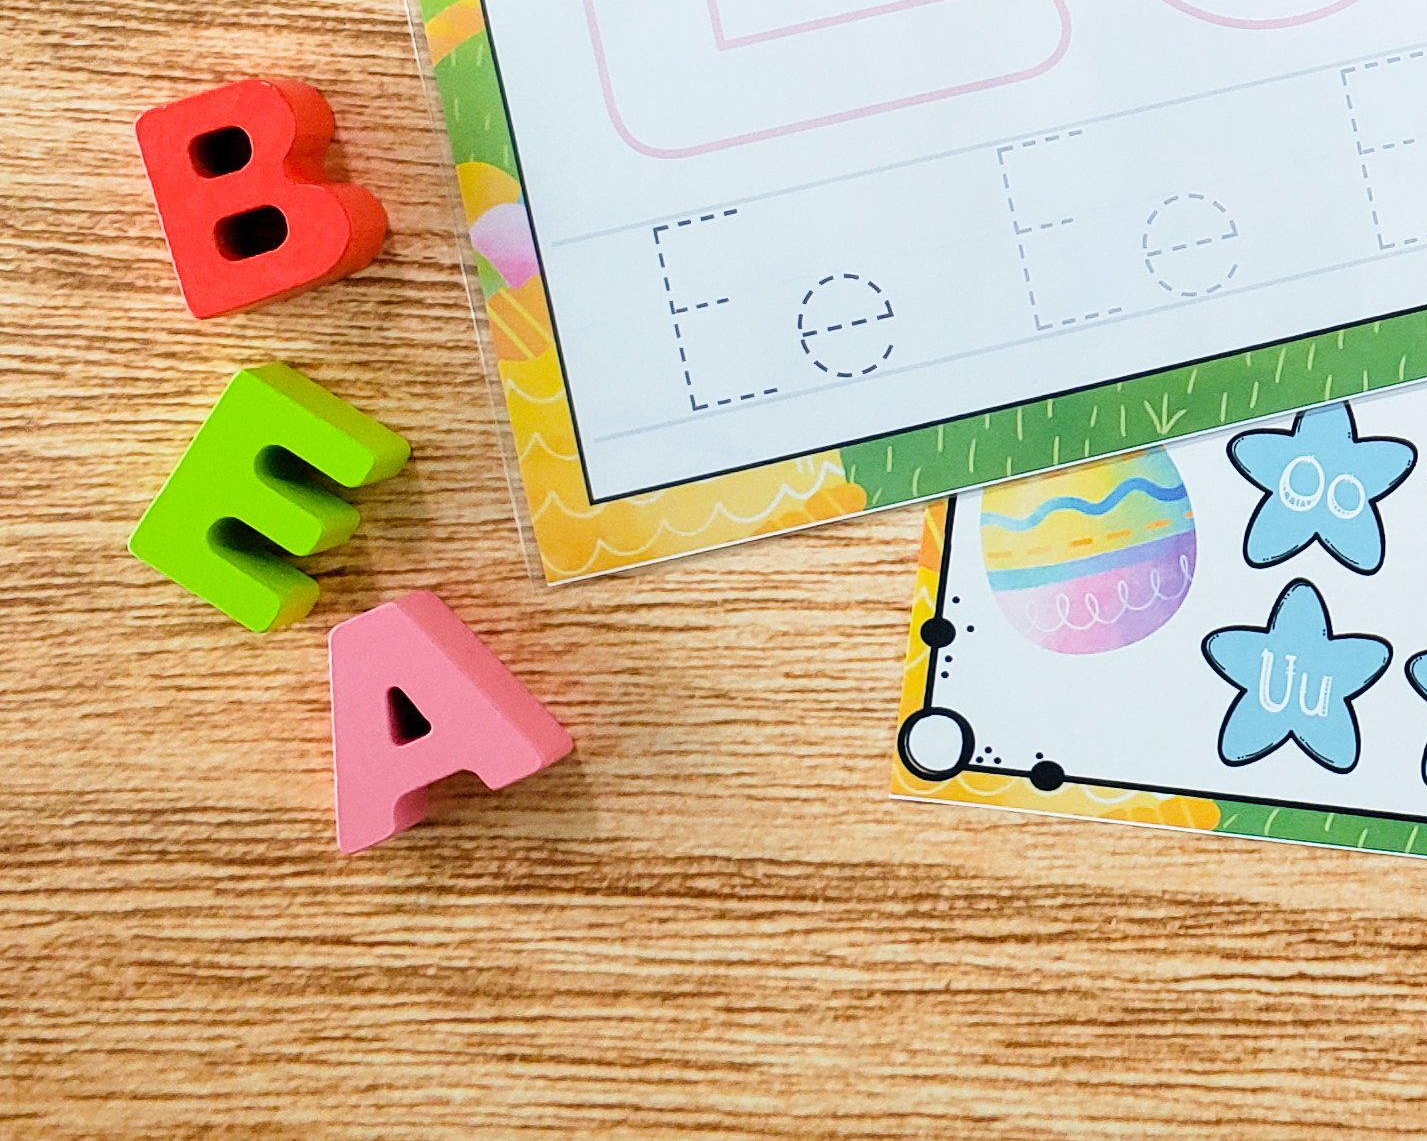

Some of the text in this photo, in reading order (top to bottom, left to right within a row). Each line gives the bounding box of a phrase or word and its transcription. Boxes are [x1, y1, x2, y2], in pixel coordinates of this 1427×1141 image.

[135, 78, 390, 320] B
[652, 208, 896, 412] Ee
[996, 129, 1239, 331] Ee
[127, 362, 412, 634] E
[1279, 455, 1366, 519] Oo
[328, 590, 576, 856] A
[1258, 648, 1332, 717] Uu
